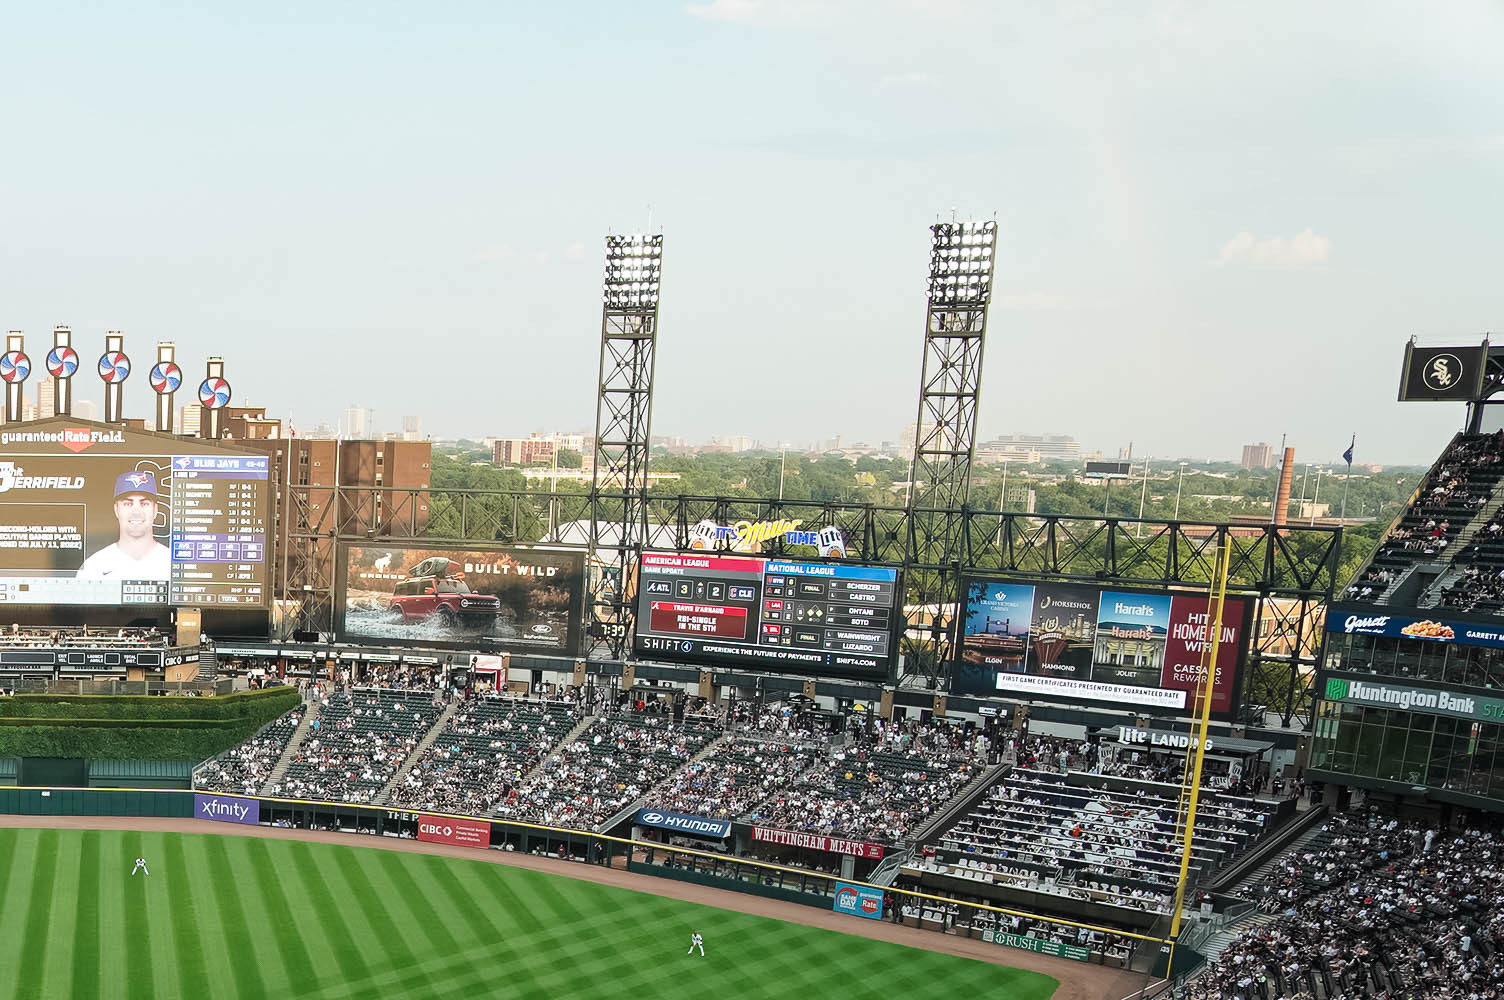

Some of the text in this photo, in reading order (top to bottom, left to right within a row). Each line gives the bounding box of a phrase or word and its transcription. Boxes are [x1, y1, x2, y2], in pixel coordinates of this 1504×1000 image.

[2, 430, 64, 444] guaranteed
[64, 431, 90, 442] Rate
[695, 525, 716, 539] Lite
[734, 519, 803, 545] Miller
[786, 532, 818, 545] TIME
[821, 530, 841, 546] Lite
[645, 557, 710, 567] AMERICAN LEAGUE
[464, 563, 510, 574] BUILT
[662, 567, 684, 575] UPDATE
[768, 564, 835, 575] NATIONAL LEAGUE
[656, 583, 753, 598] ATL 3 2 CLE
[847, 583, 881, 591] SCHERZER
[849, 593, 876, 601] CASTRO
[677, 615, 717, 624] RBI-SINGLE
[1188, 612, 1210, 625] HIT
[678, 622, 717, 632] IN THE 5TH
[1173, 623, 1206, 641] HOME
[1345, 615, 1390, 632] Garrett
[1466, 630, 1497, 640] GARRETT
[837, 632, 881, 641] WAINWRIGHT
[842, 643, 874, 651] LUZARDO
[703, 645, 739, 655] EXPERIENCE
[753, 649, 777, 657] FUTURE
[788, 653, 822, 662] PAYMENTS
[1042, 663, 1075, 672] HAMMOND
[1173, 663, 1222, 675] CAESAS
[1116, 670, 1137, 678] JOLIET
[1002, 675, 1019, 683] FIRST
[1019, 677, 1036, 685] GAME
[1037, 679, 1077, 689] CERTIFICATES
[1079, 683, 1113, 692] PRESENTED
[1123, 686, 1163, 697] GUARANTEED
[1164, 691, 1179, 699] RATE
[1349, 681, 1475, 714] Huntington Bank
[1117, 727, 1147, 745] Lite
[202, 800, 249, 822] xfinity
[420, 824, 442, 835] CIBC
[665, 816, 723, 833] HYUNDAI
[754, 827, 826, 850] WHITTINGHAM
[829, 838, 864, 857] MEATS
[840, 899, 857, 908] DAY
[862, 900, 877, 909] Rate
[1006, 935, 1037, 951] RUSH
